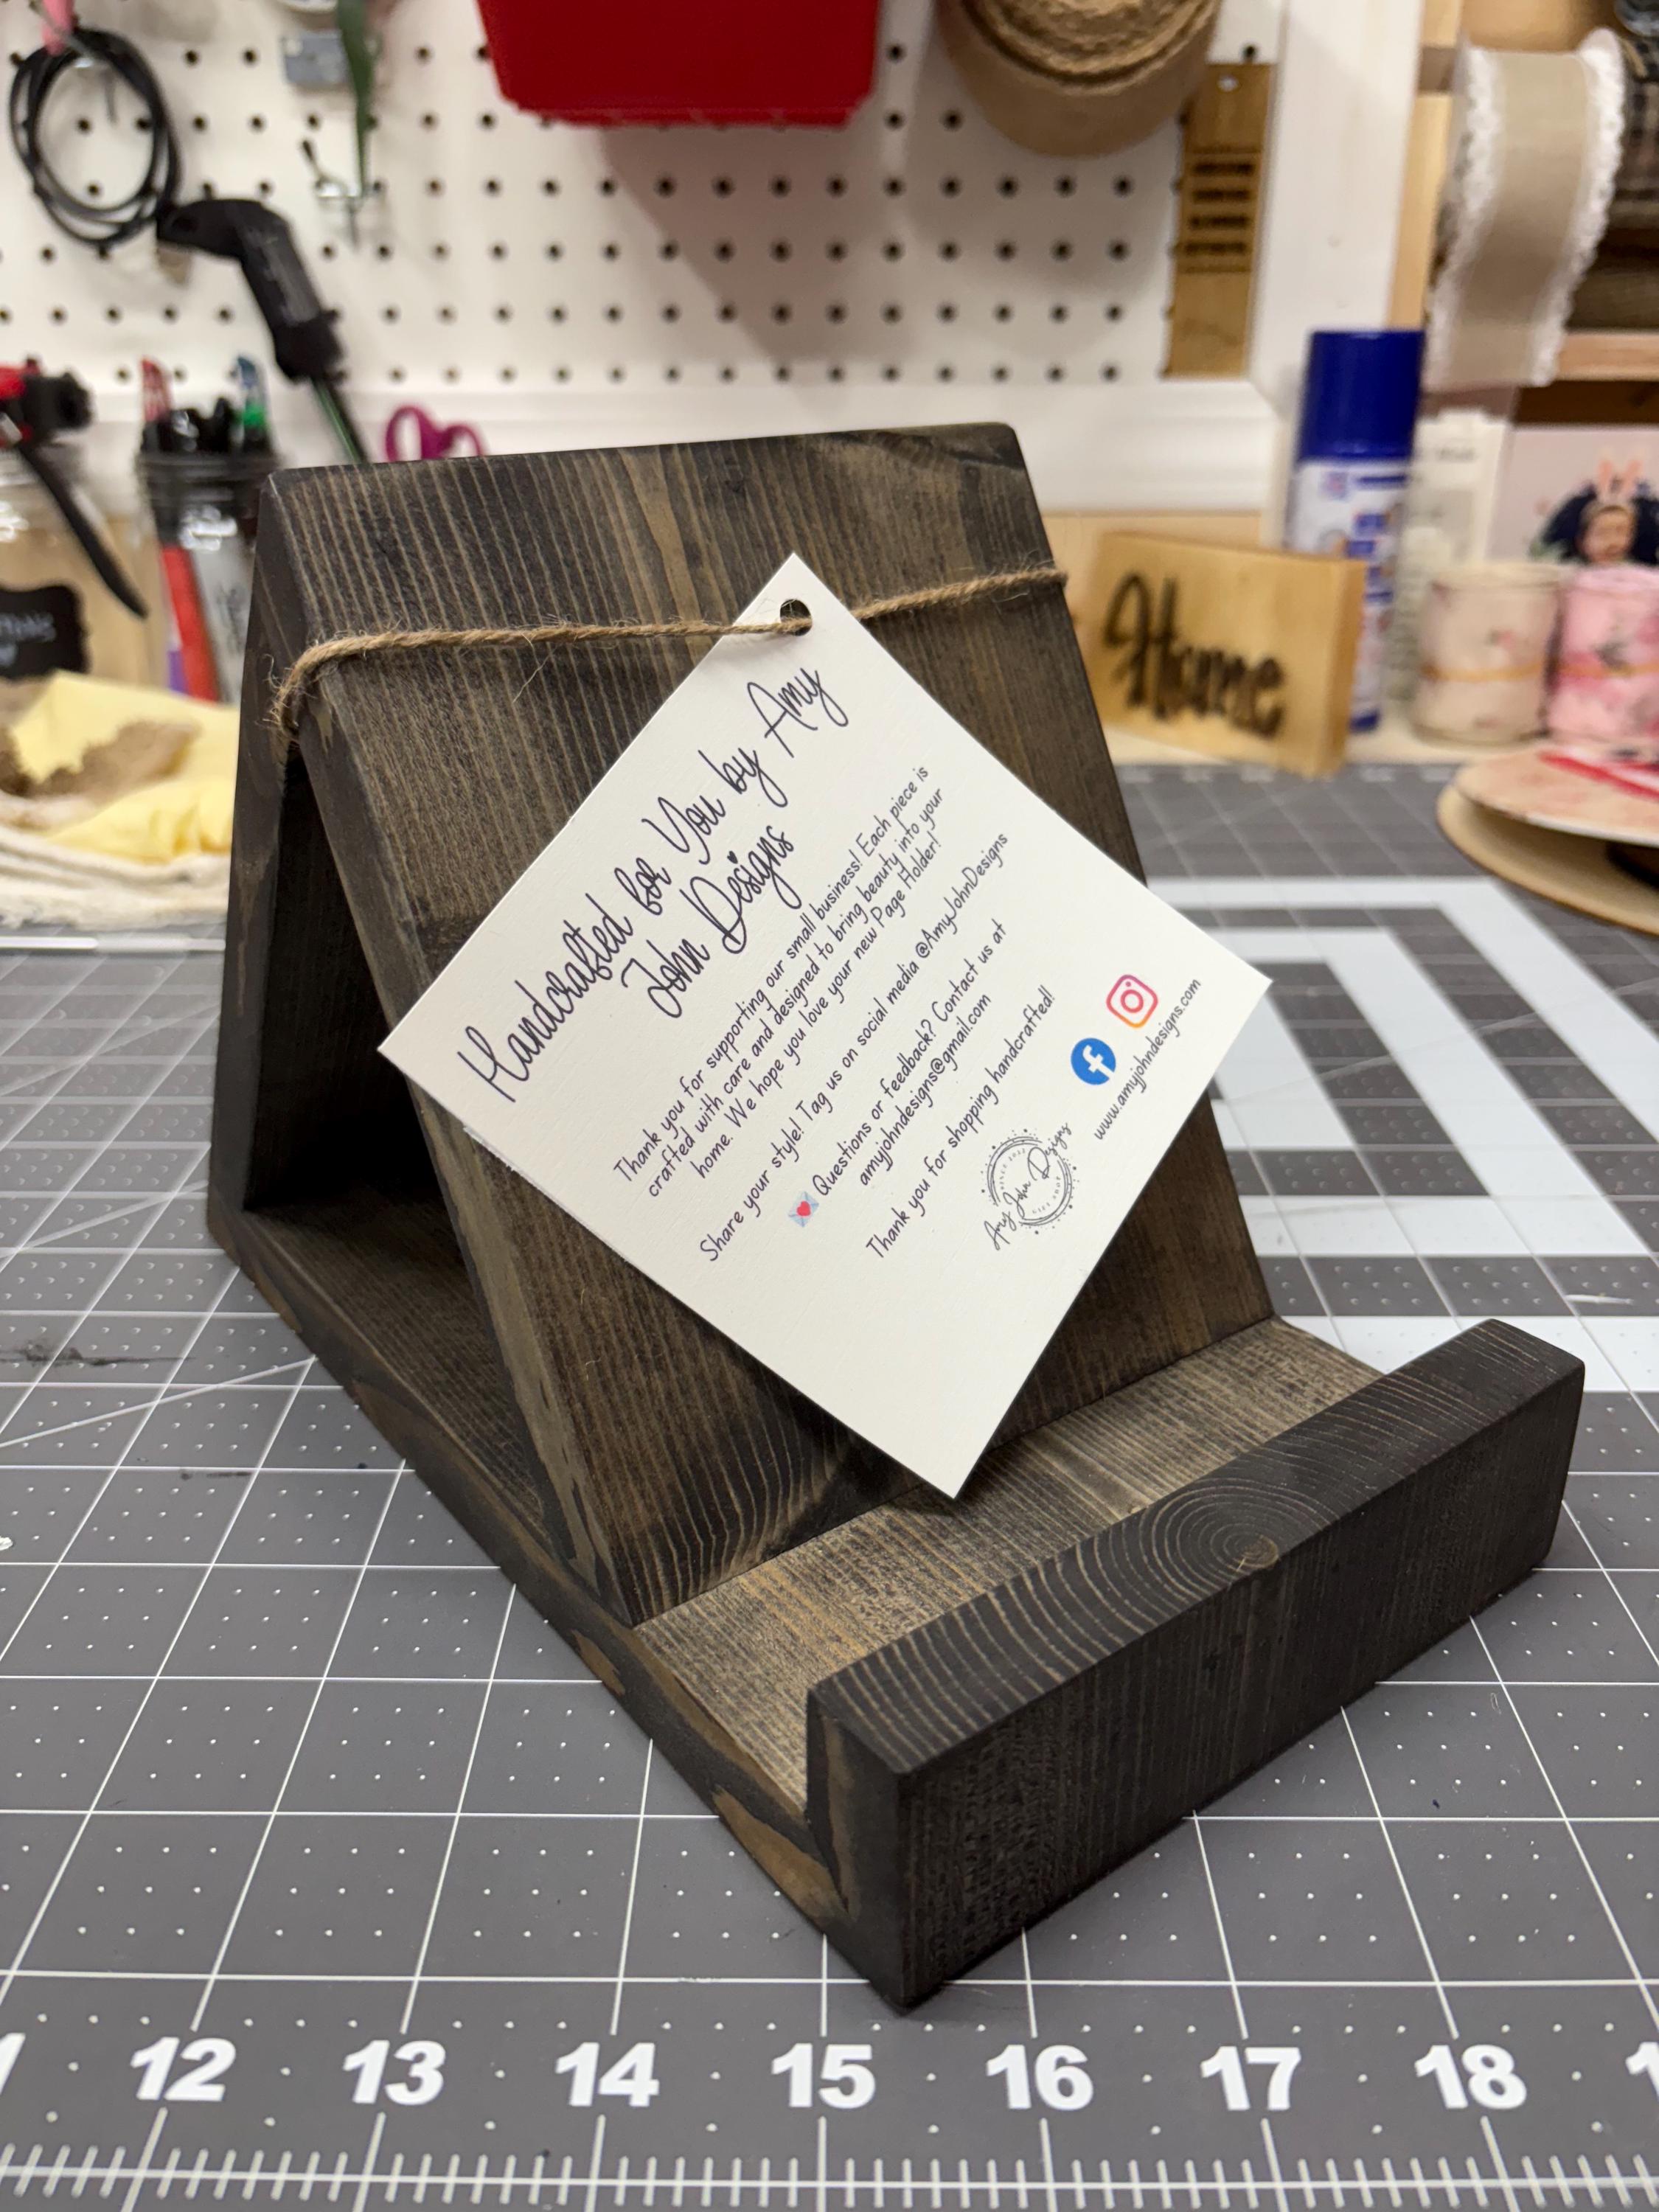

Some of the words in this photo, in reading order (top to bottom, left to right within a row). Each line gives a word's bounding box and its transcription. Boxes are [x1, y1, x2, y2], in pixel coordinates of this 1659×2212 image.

[697, 747, 788, 807] by
[746, 667, 849, 758] Amy
[613, 857, 672, 916] for
[620, 938, 710, 1018] John
[678, 824, 802, 954] Designs
[641, 795, 726, 865] You
[456, 892, 633, 1102] Handcrafted
[613, 1128, 661, 1181] Thank
[660, 1099, 685, 1139] you
[679, 1069, 703, 1097] for
[706, 988, 771, 1068] supporting
[765, 959, 785, 987] our
[786, 911, 816, 959] small
[808, 849, 863, 920] business!
[855, 815, 891, 857] Each
[889, 781, 917, 827] piece
[912, 767, 928, 782] is
[649, 1126, 695, 1197] crafted
[694, 1093, 723, 1133] with
[723, 1057, 751, 1094] care
[751, 1018, 774, 1057] and
[766, 953, 820, 1025] designed
[813, 942, 834, 960] to
[826, 902, 869, 942] bring
[855, 852, 902, 902] beauty
[894, 823, 919, 852] into
[919, 788, 942, 830] your
[689, 1134, 733, 1178] home.
[723, 1097, 757, 1127] We
[748, 1059, 784, 1096] hope
[782, 1027, 806, 1066] you
[798, 996, 828, 1027] love
[827, 959, 852, 1004] your
[853, 927, 877, 959] new
[869, 889, 905, 928] Page
[897, 830, 941, 889] Holder!
[700, 1211, 743, 1261] Share
[742, 1169, 769, 1217] your
[770, 1116, 804, 1168] style!
[795, 1091, 832, 1121] Tag
[826, 1070, 842, 1090] us
[841, 1048, 858, 1068] on
[857, 996, 888, 1046] social
[886, 961, 919, 1004] media
[914, 833, 1007, 958] @AmyJohnDesigns
[812, 1122, 872, 1195] Questions
[871, 1099, 883, 1119] or
[880, 1018, 936, 1098] feedback?
[931, 958, 978, 1021] Contact
[977, 945, 993, 964] us
[991, 918, 1006, 944] at
[1093, 979, 1200, 1139] www.amyjohndesigns.com
[860, 994, 991, 1186] amyjohndesigns@gmail.com
[865, 1207, 910, 1258] Thank
[908, 1178, 931, 1217] you
[923, 1149, 947, 1176] for
[945, 1084, 998, 1148] shopping
[984, 984, 1054, 1083] handcrafted!
[984, 1211, 1017, 1251] Amy
[1003, 1180, 1032, 1220] John
[1027, 1123, 1072, 1180] Designs
[130, 2037, 236, 2101] 12
[344, 2039, 445, 2105] 13
[556, 2042, 659, 2107] 14
[772, 2043, 875, 2110] 15
[987, 2045, 1093, 2110] 16
[1200, 2046, 1301, 2110] 17
[1414, 2045, 1527, 2110] 18
